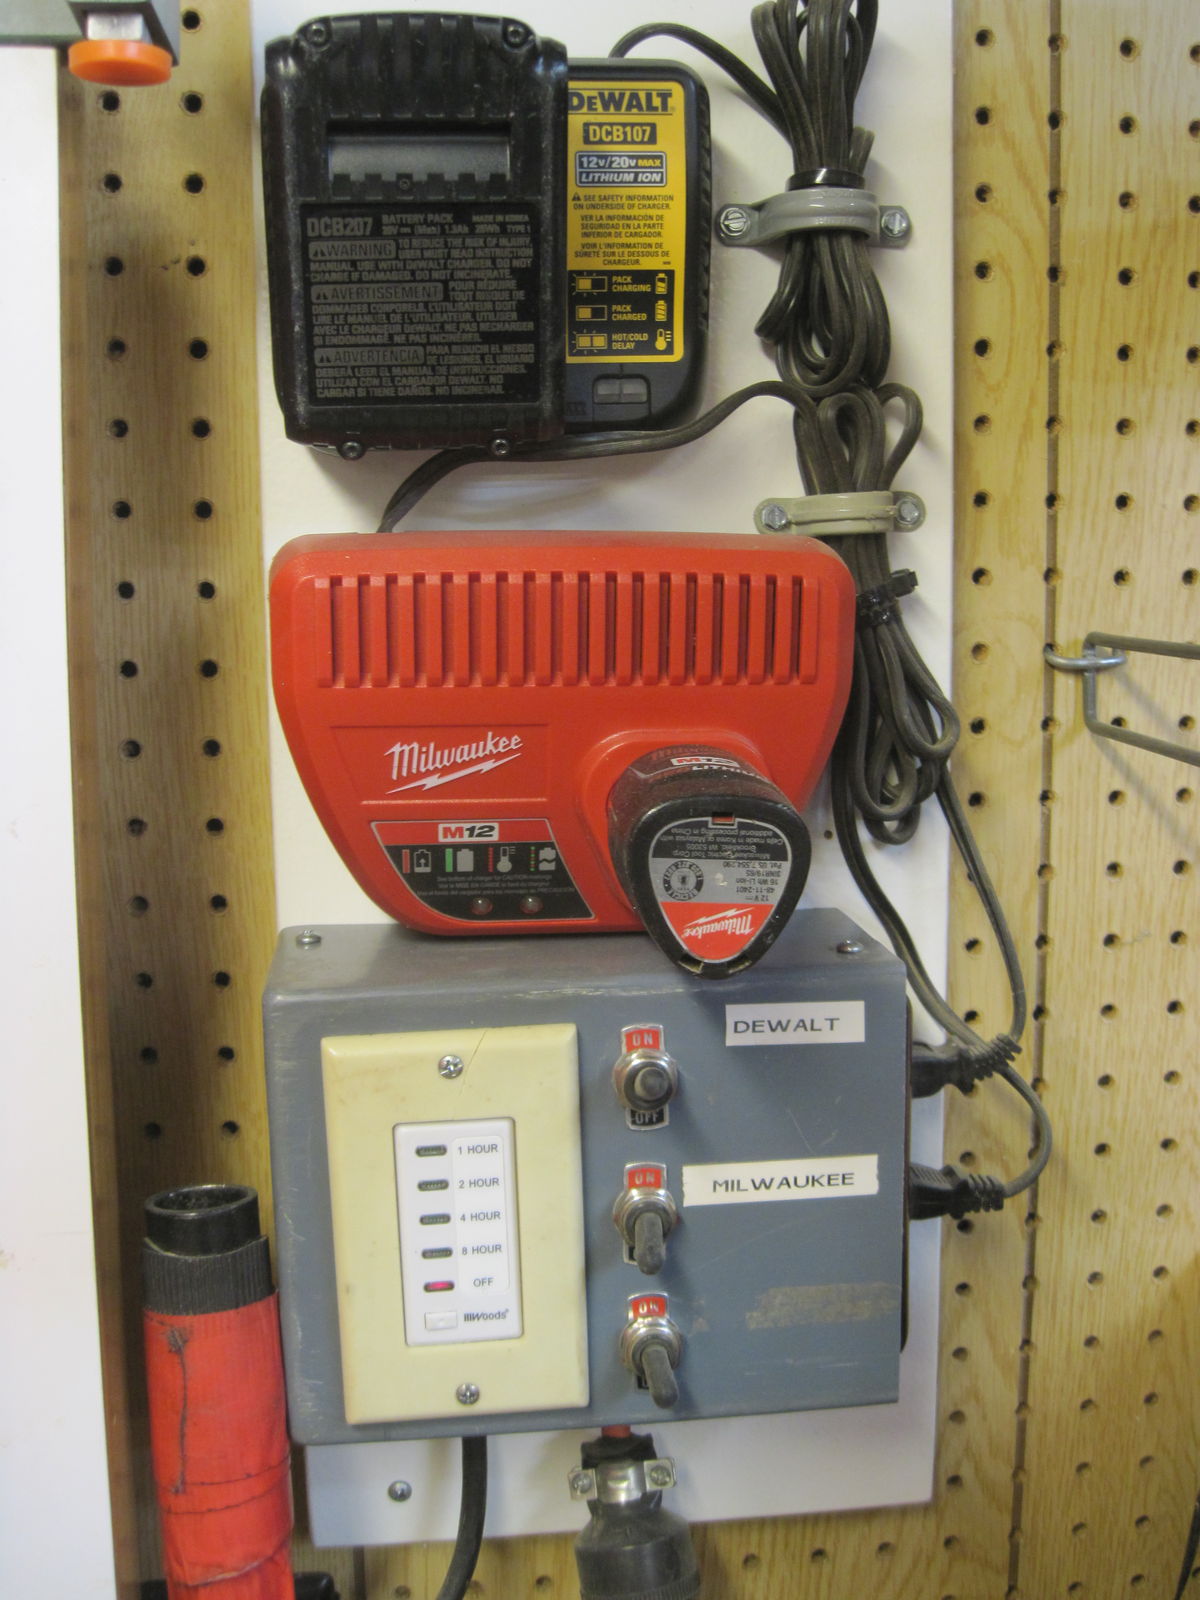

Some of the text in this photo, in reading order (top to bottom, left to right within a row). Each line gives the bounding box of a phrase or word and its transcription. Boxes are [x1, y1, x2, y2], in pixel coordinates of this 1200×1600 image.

[589, 125, 651, 142] DCB107
[637, 159, 661, 167] MAX
[581, 172, 662, 182] LITHIUM ION
[306, 217, 374, 237] DCB207
[382, 213, 425, 225] BATTERY
[328, 242, 392, 257] WARNING
[612, 275, 632, 283] PACK
[331, 286, 439, 299] AVERTISSEMENT
[612, 284, 652, 292] CHARGING
[612, 304, 631, 312] PACK
[612, 313, 647, 321] CHARGED
[612, 333, 648, 341] HOT/COLD
[612, 342, 635, 350] DELAY
[334, 350, 420, 363] ADVERTENCIA
[384, 731, 523, 781] Milwaukee
[441, 824, 496, 840] M12
[684, 914, 754, 940] Milwaukee
[733, 1018, 840, 1034] DEWALT
[632, 1032, 653, 1046] ON
[635, 1112, 659, 1125] OFF
[458, 1144, 498, 1155] 1 HOUR
[458, 1178, 500, 1189] 2 HOUR
[634, 1172, 655, 1185] ON
[712, 1172, 855, 1193] MILWAUKEE
[459, 1211, 501, 1223] 4 HOUR
[461, 1244, 503, 1256] 8 HOUR
[472, 1276, 494, 1288] OFF
[638, 1301, 659, 1314] ON
